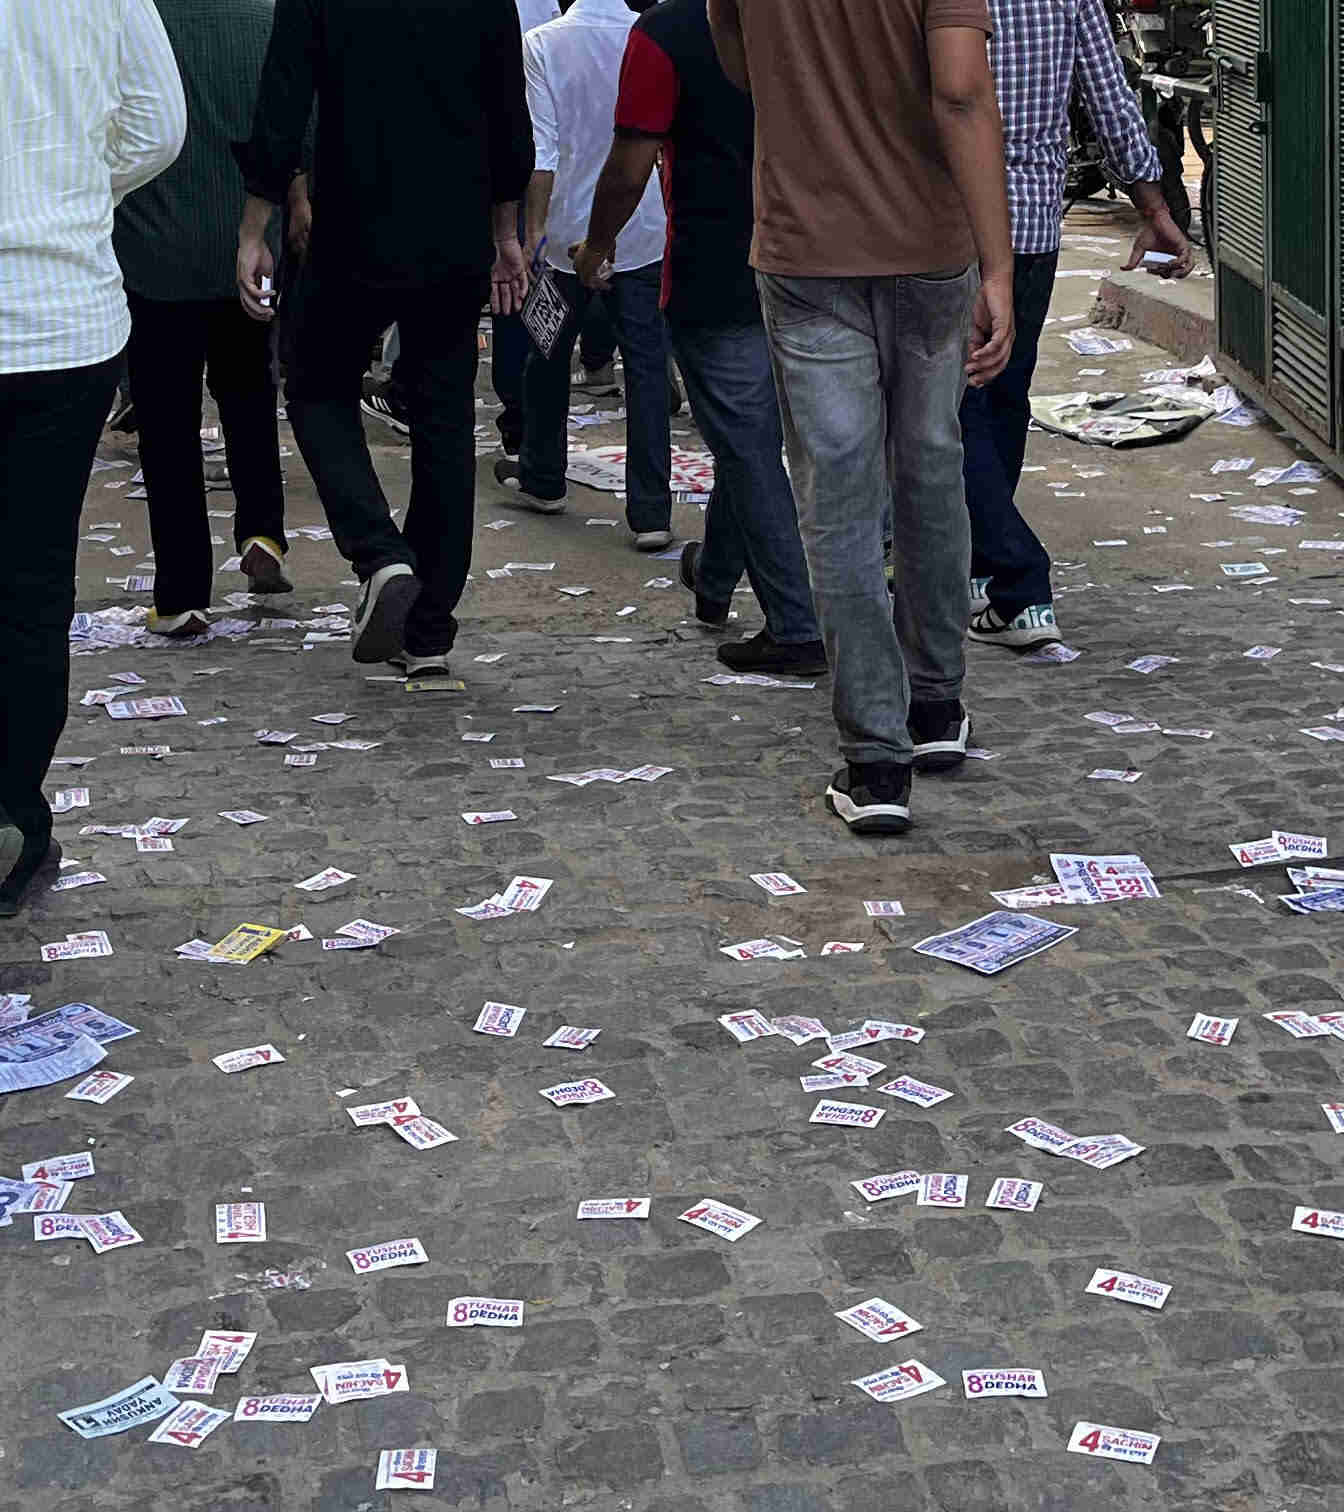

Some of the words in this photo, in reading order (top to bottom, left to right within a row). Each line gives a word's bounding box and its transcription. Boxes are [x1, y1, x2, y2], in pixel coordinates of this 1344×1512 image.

[547, 1085, 585, 1096] DEDHA
[583, 1080, 604, 1095] 8
[820, 1104, 861, 1115] DEDHA
[861, 1109, 878, 1124] 8
[40, 1218, 55, 1236] 8
[1301, 1212, 1319, 1228] 4
[366, 1242, 414, 1256] TUSHAR
[370, 1249, 418, 1263] DEDHA
[353, 1253, 370, 1269] 8
[1097, 1277, 1117, 1292] 4
[453, 1302, 468, 1322] 8
[468, 1302, 520, 1312] TUSHAR
[468, 1309, 519, 1321] DEDHA
[967, 1375, 983, 1393] 8
[981, 1373, 1036, 1382] TUSHAR
[984, 1381, 1038, 1391] DEDHA
[243, 1398, 259, 1415] 8
[258, 1397, 316, 1405] TUSHAR
[258, 1403, 313, 1414] DEDHA
[1079, 1431, 1102, 1453] 4
[1102, 1437, 1153, 1451] SACHIN
